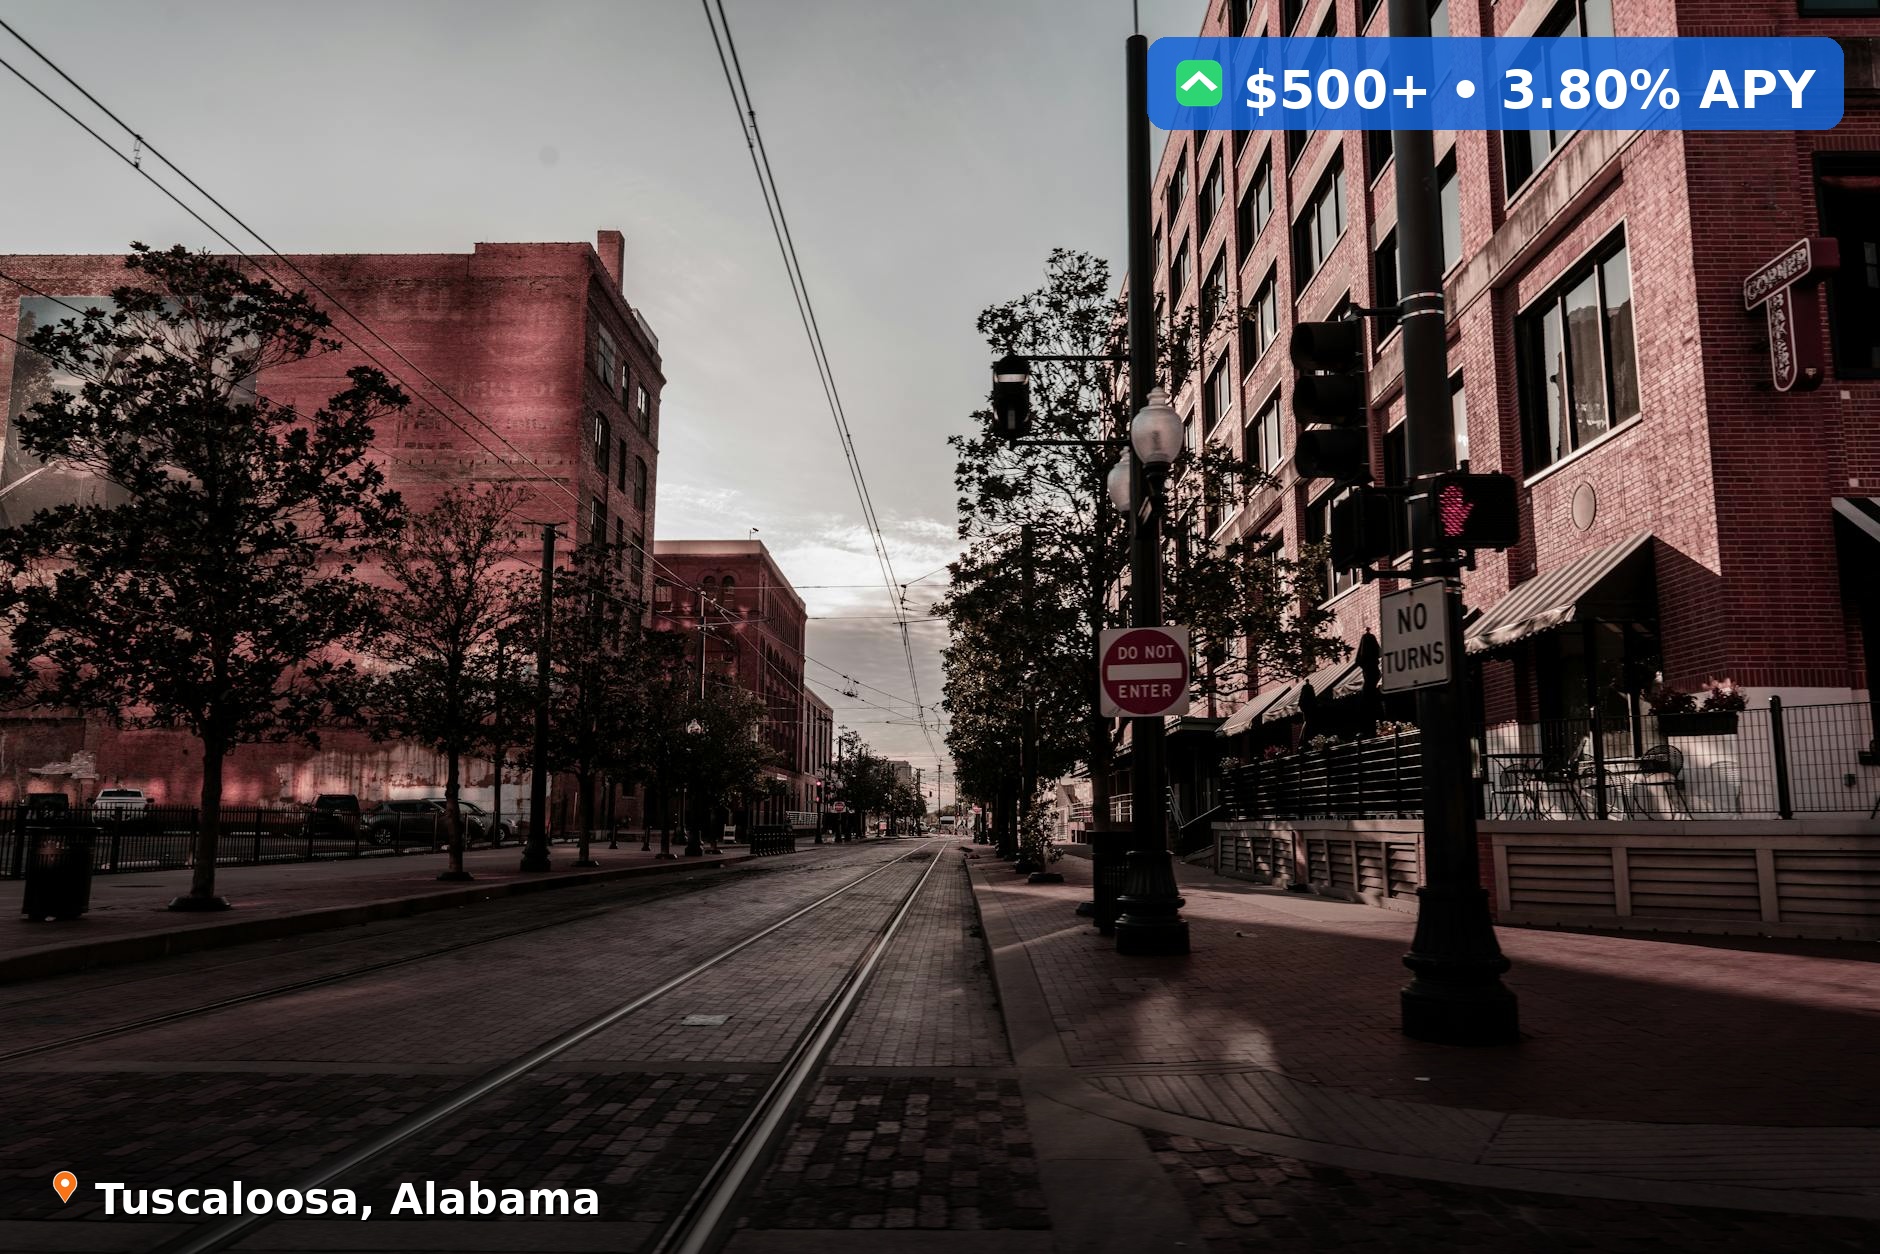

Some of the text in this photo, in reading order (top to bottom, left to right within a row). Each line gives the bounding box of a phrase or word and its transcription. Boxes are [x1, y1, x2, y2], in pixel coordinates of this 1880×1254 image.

[1746, 247, 1808, 301] CORNER
[1770, 292, 1791, 382] BAKERY
[1398, 602, 1427, 635] NO
[1117, 644, 1174, 660] DO NOT
[1384, 641, 1444, 674] TURNS
[1118, 683, 1172, 698] ENTER
